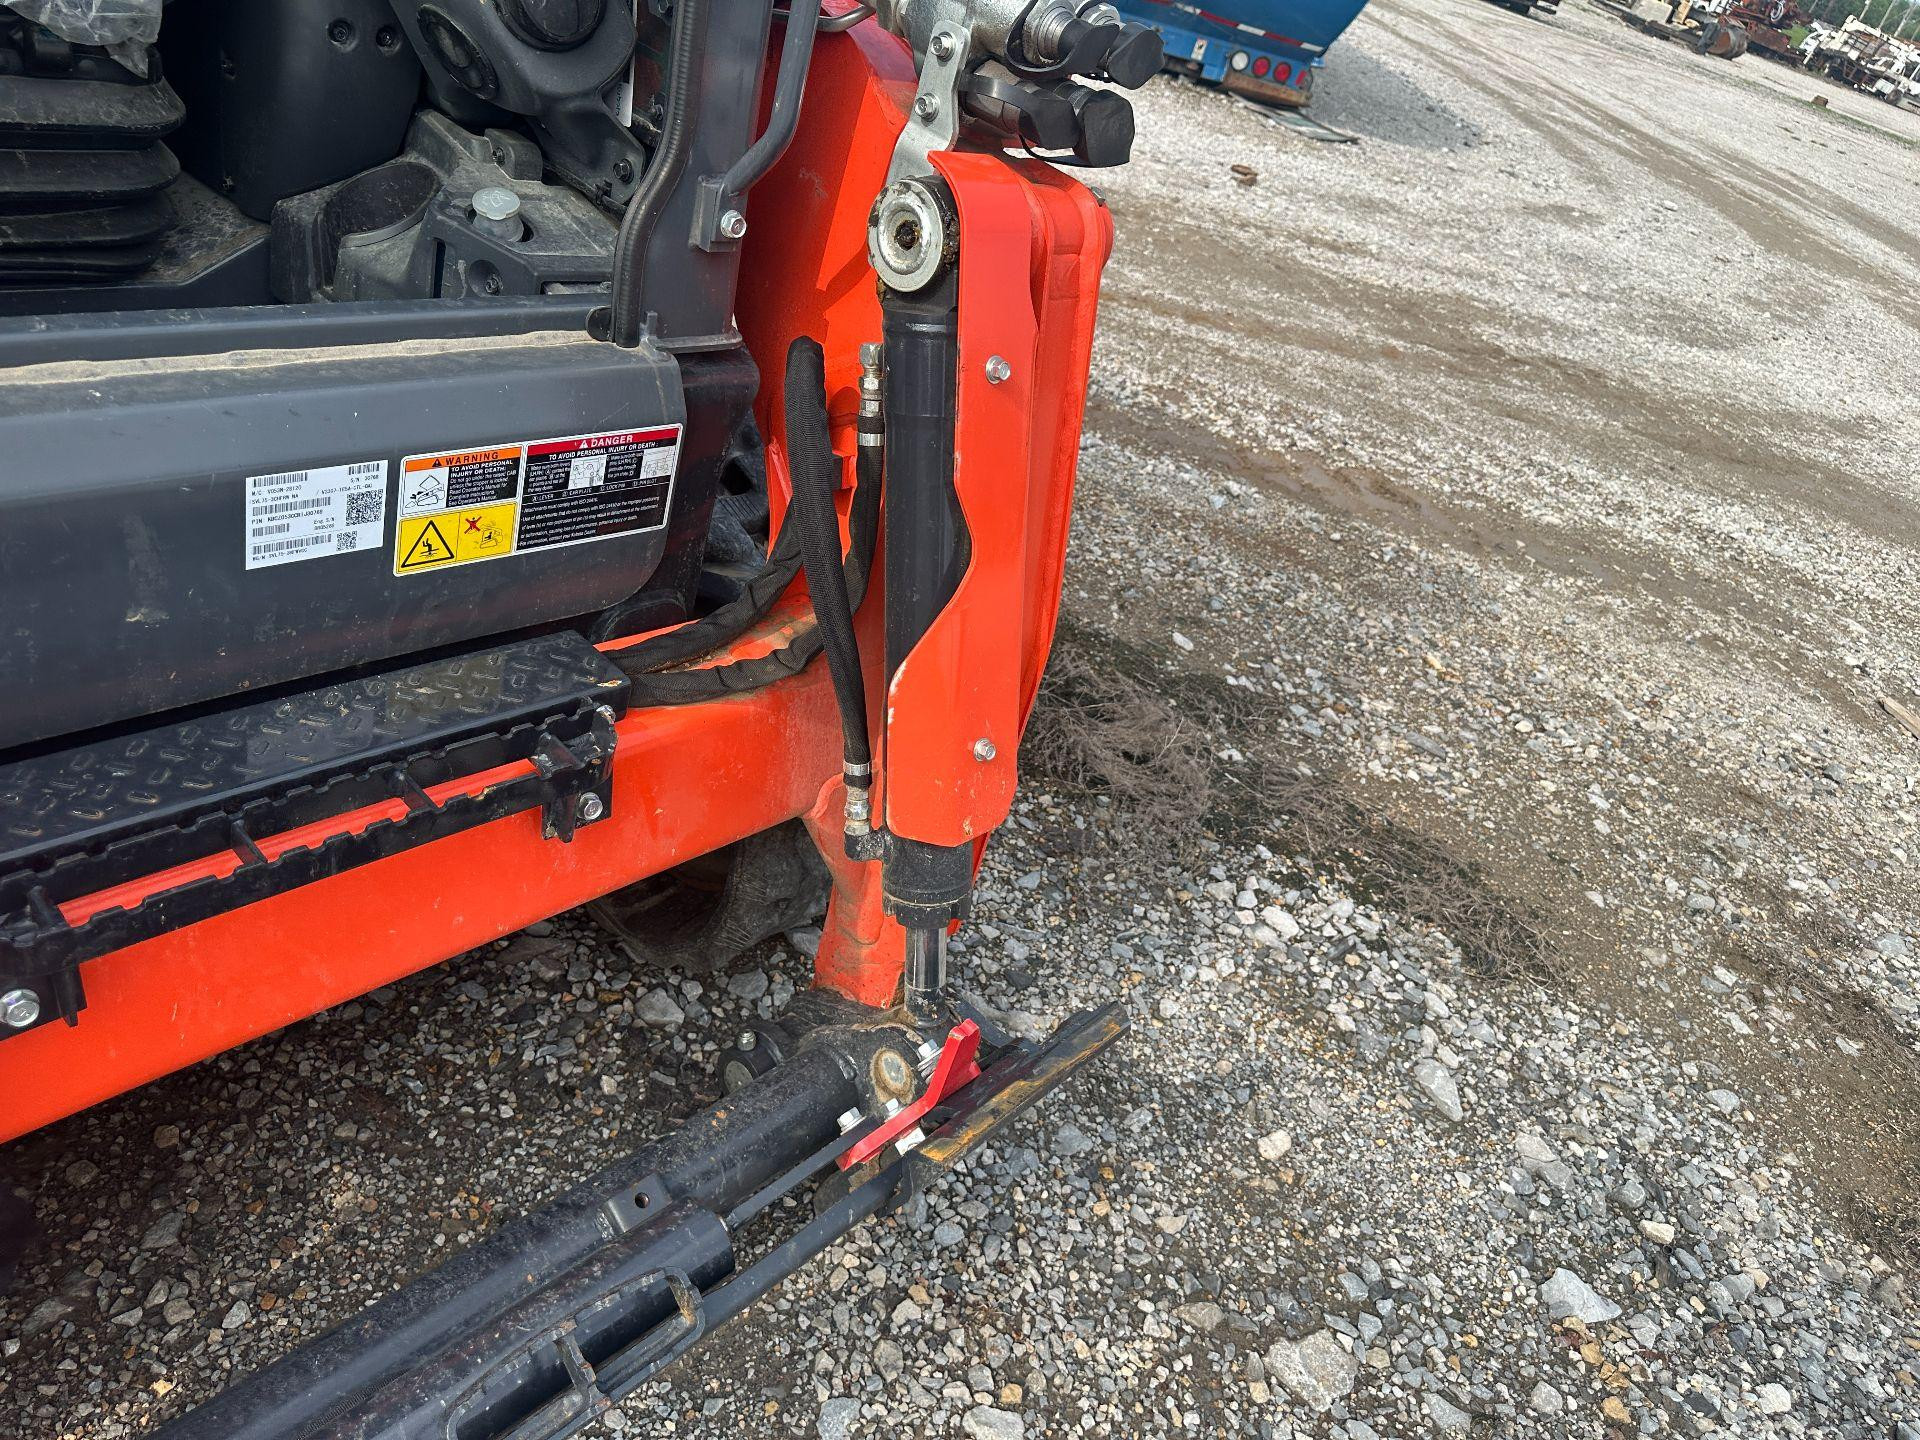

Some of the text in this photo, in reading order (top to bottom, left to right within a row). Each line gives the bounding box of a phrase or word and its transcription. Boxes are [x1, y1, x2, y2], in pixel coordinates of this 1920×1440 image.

[591, 434, 633, 448] DANGER
[445, 451, 499, 466] WARNING
[558, 451, 576, 460] AVOID
[576, 447, 607, 457] PERSONAL
[608, 445, 628, 453] INJURY
[481, 459, 513, 469] PERSONAL
[450, 470, 472, 478] INJURY
